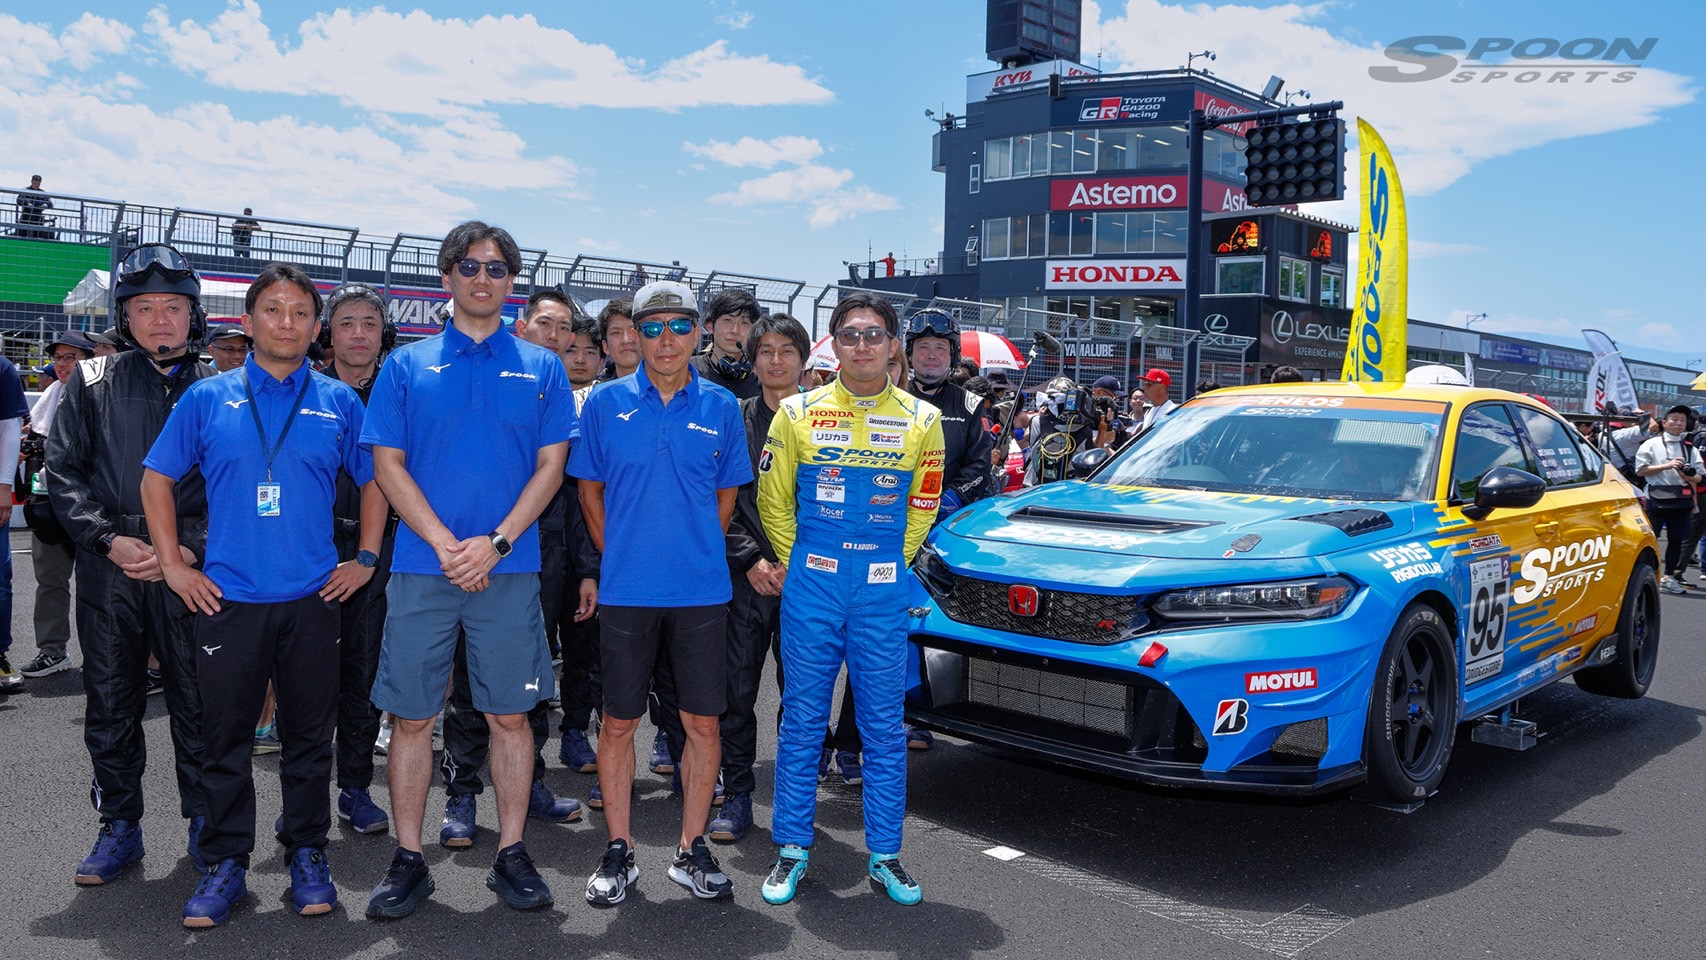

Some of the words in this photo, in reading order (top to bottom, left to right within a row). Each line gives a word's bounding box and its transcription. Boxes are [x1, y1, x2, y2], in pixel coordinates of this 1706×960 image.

[995, 70, 1033, 88] KYB
[1124, 96, 1166, 104] TOYOTA
[1081, 105, 1118, 119] GR
[1120, 111, 1158, 119] Racing
[1068, 182, 1177, 208] Astemo
[1051, 265, 1183, 283] HONDA
[1257, 397, 1346, 407] ENEOS
[809, 410, 855, 418] HONDA
[868, 417, 908, 428] BRIDGESTONE
[816, 433, 849, 442] リジカラ
[812, 446, 905, 462] SPOON
[838, 458, 899, 467] SPORTS
[875, 475, 897, 485] Arai
[1502, 559, 1509, 576] 2
[1514, 535, 1612, 605] SPOON
[1542, 567, 1605, 599] SPORTS
[1470, 580, 1507, 657] 95
[1248, 671, 1316, 693] MOTUL
